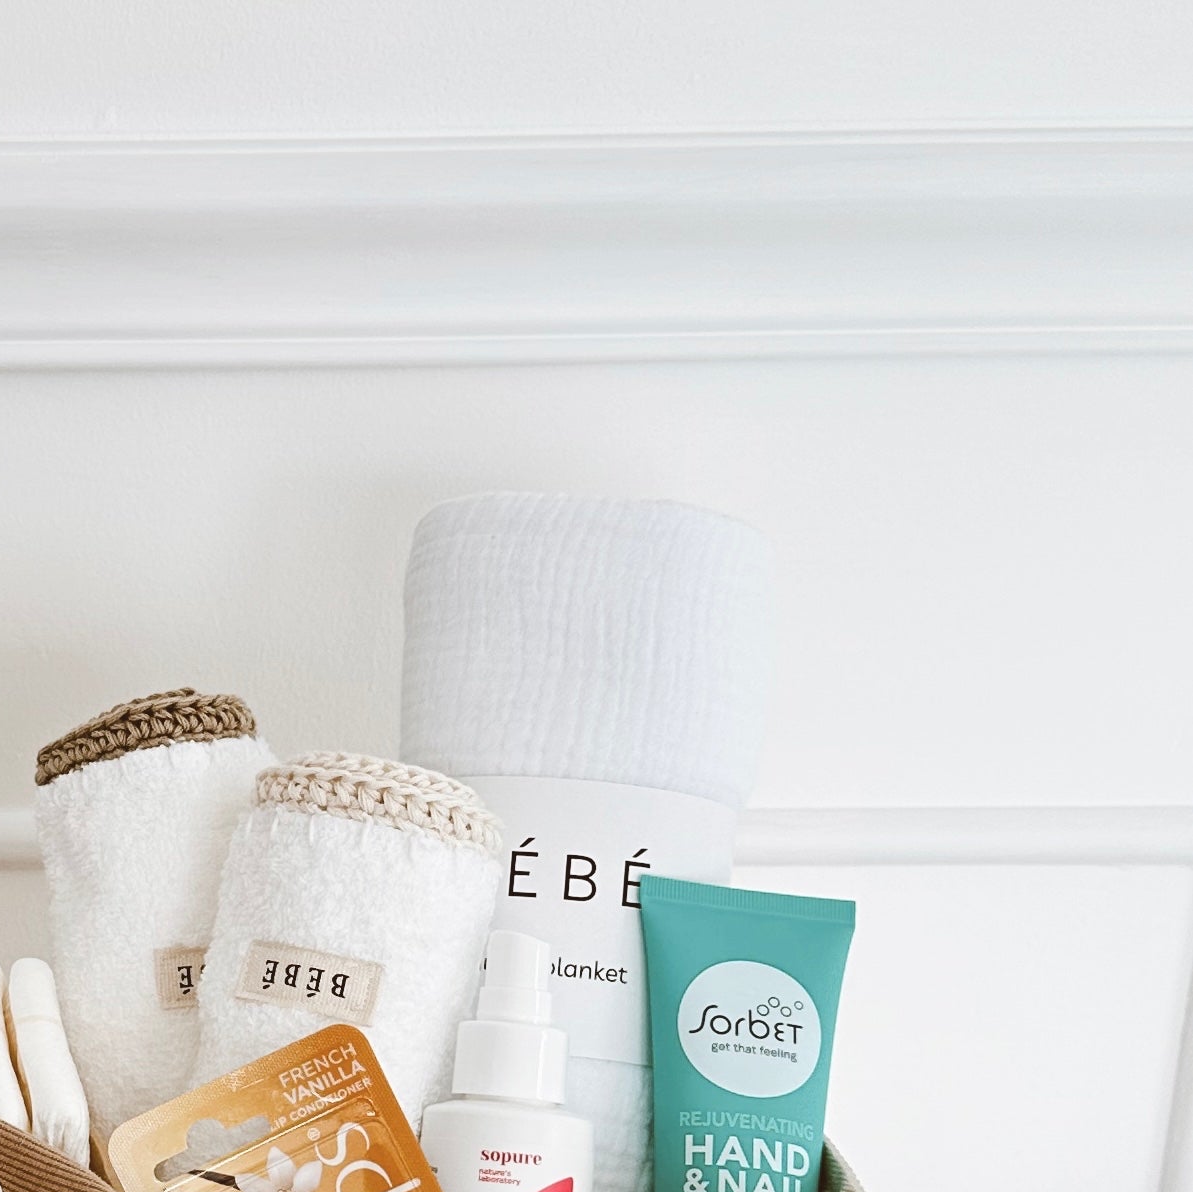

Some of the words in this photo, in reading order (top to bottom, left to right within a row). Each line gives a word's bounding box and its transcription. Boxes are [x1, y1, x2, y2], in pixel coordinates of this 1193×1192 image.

[507, 837, 651, 910] ÉBÉ
[261, 959, 350, 999] BÉBÉ
[278, 1042, 358, 1088] FRENCH
[733, 1043, 757, 1055] that
[759, 1046, 798, 1063] feeling
[283, 1059, 367, 1105] VANILLA
[679, 1110, 814, 1142] REJUVENATING
[479, 1149, 543, 1166] sopure
[684, 1134, 810, 1177] HAND
